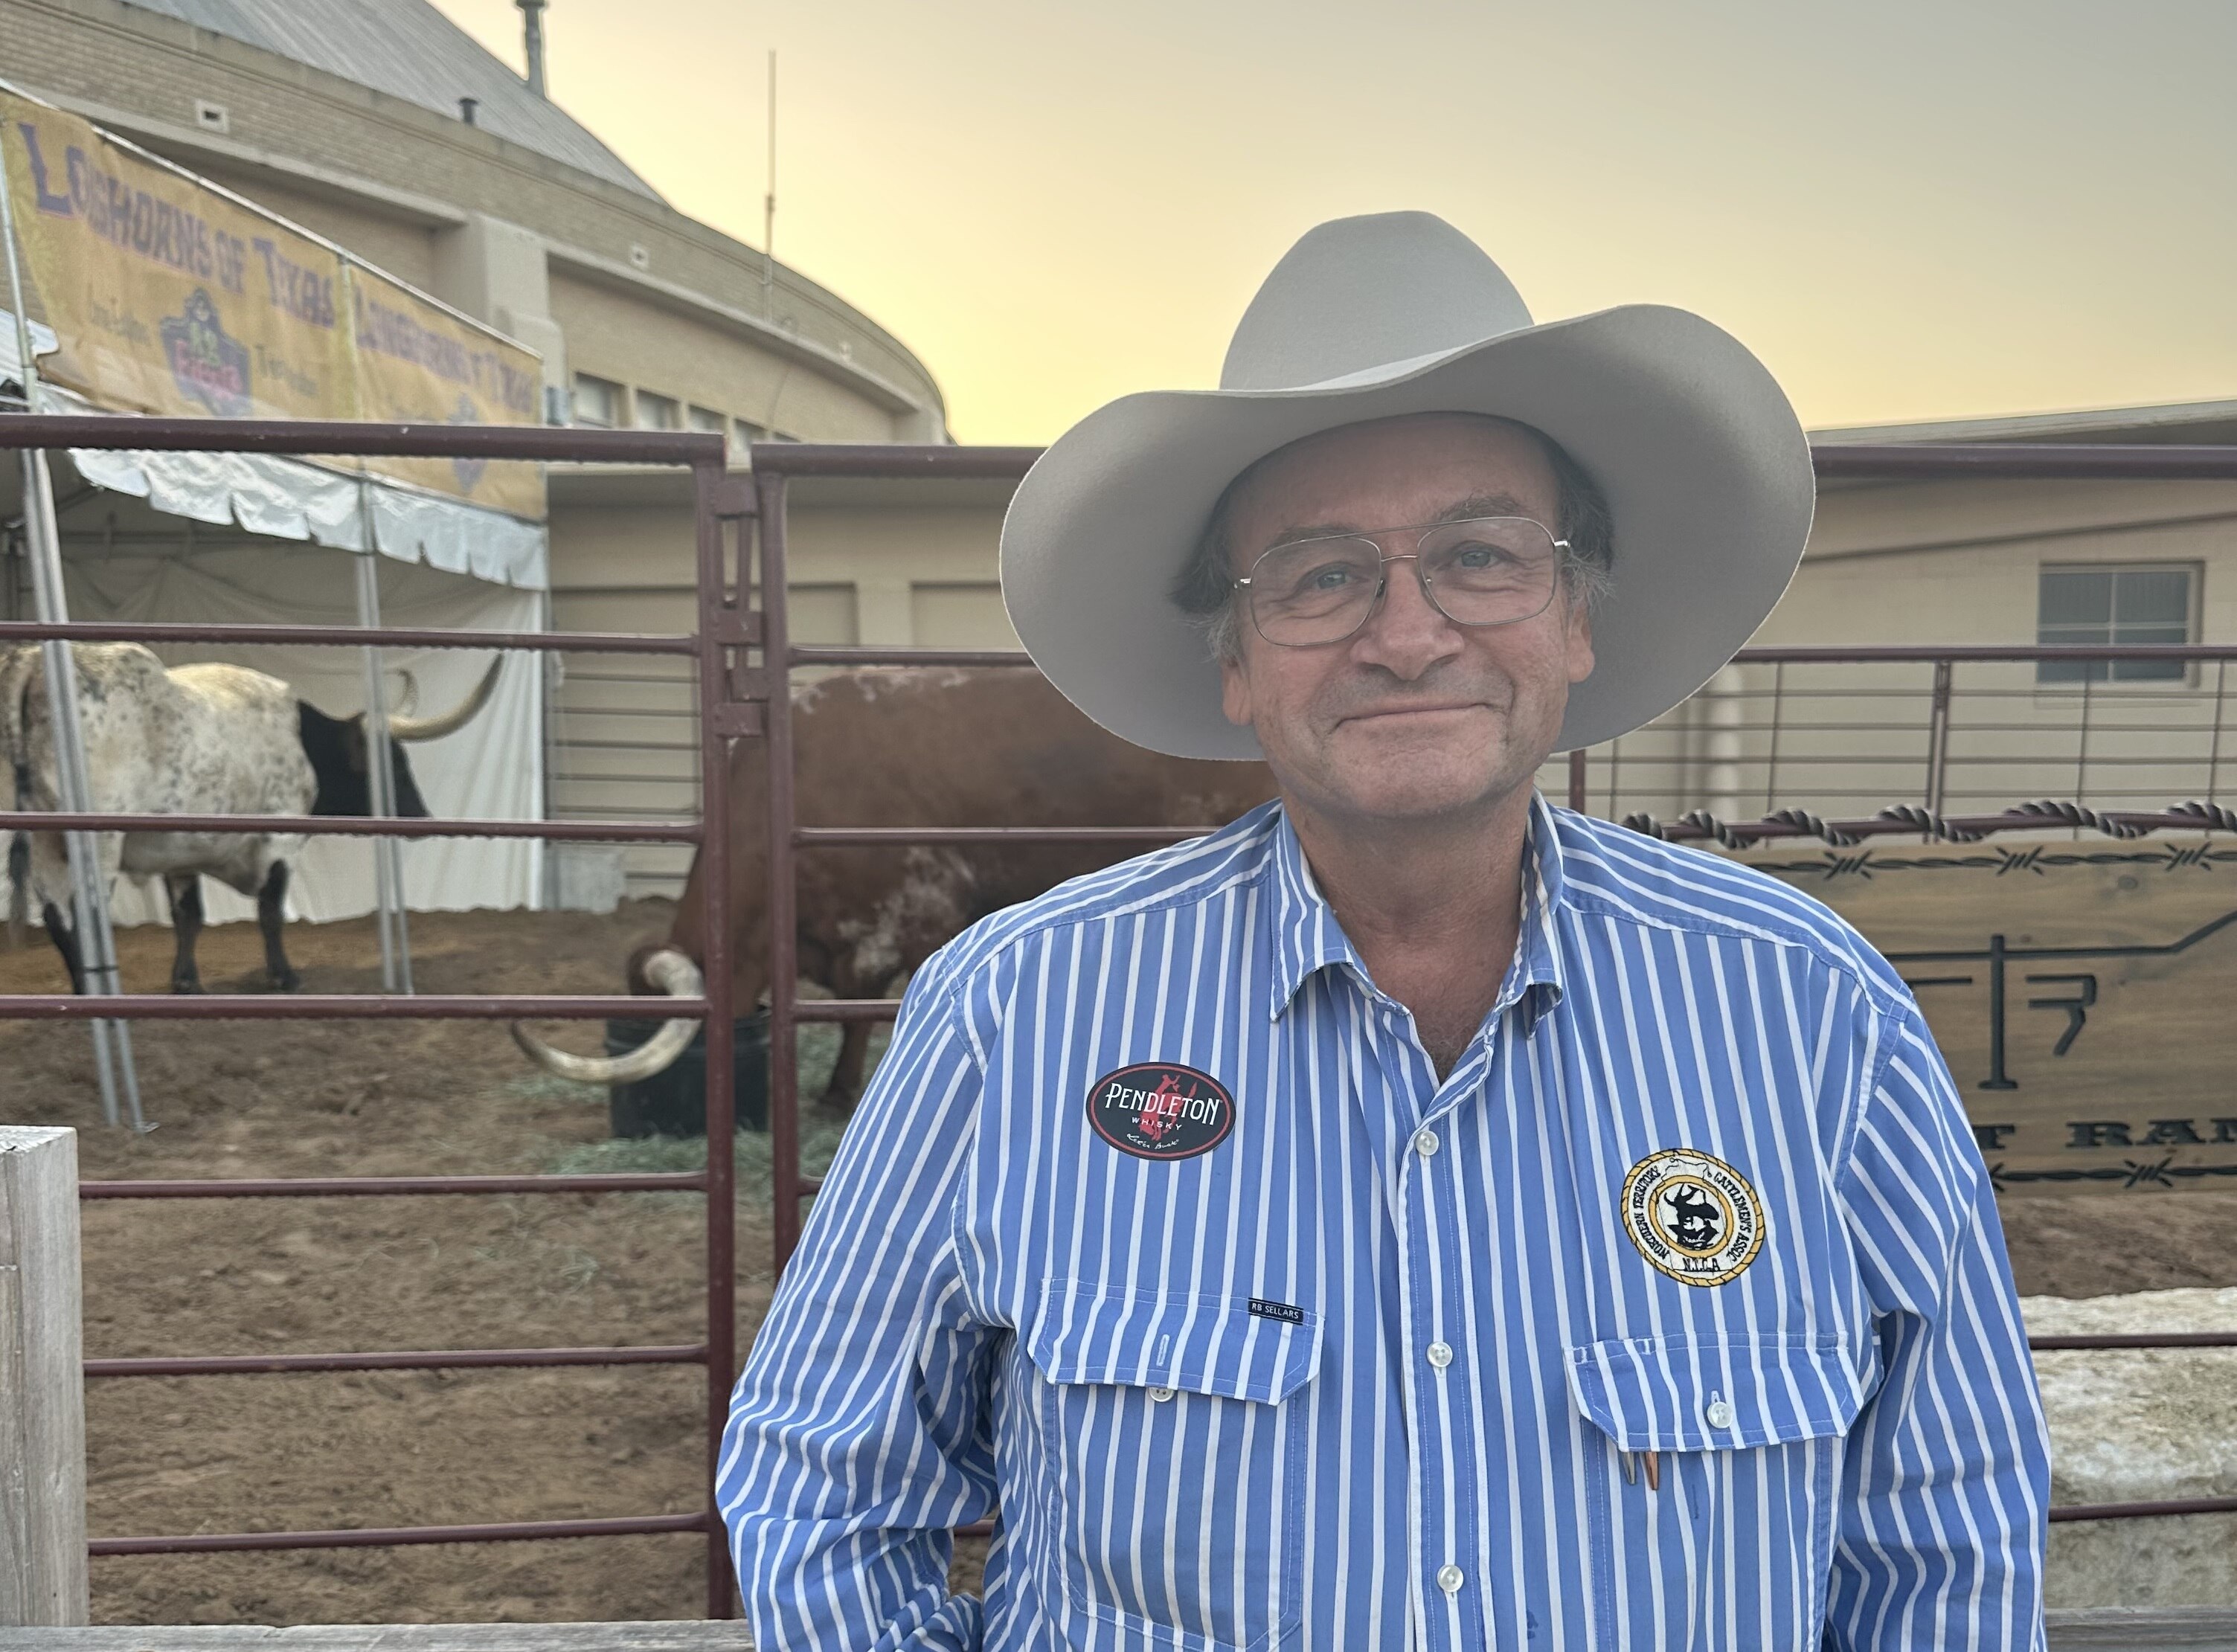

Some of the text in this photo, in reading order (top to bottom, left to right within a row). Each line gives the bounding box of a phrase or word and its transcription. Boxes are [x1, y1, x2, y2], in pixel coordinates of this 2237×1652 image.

[1105, 1083, 1221, 1125] PENDLETON
[1132, 1116, 1182, 1131] WHISKY
[1632, 1165, 1670, 1260] NORTHERN TERRITORY
[1251, 1302, 1299, 1319] RB SELLARS
